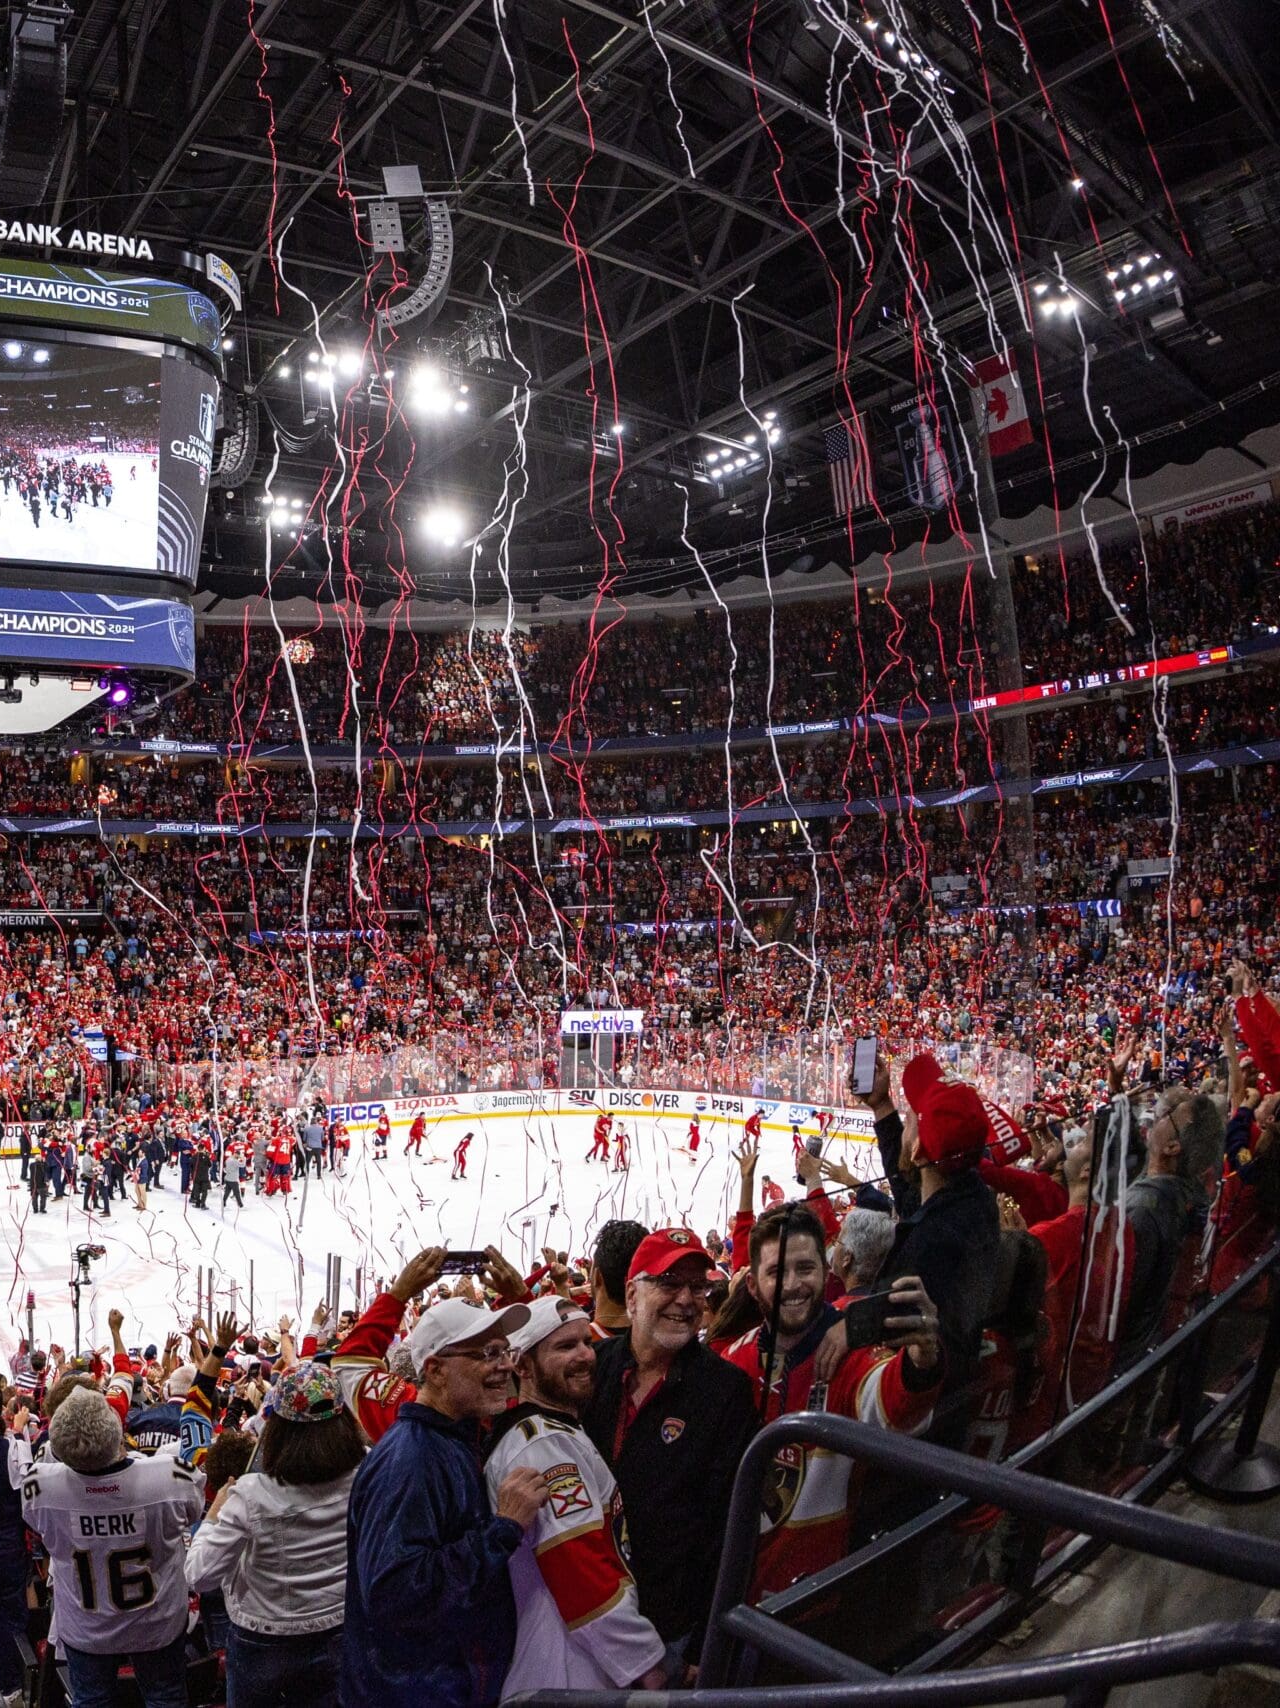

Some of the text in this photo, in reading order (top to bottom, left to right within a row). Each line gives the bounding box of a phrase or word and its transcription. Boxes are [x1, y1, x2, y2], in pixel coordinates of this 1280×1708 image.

[69, 229, 154, 261] ARENA
[119, 295, 150, 309] 2024
[1184, 491, 1255, 517] UNRULY FAN?
[108, 622, 135, 634] 2024
[1103, 673, 1110, 684] 2
[570, 1015, 634, 1032] nextiva
[395, 1096, 458, 1110] HONDA
[609, 1092, 679, 1108] DISCOVER
[712, 1100, 743, 1112] PEPSI
[325, 1104, 385, 1121] EICO
[789, 1107, 810, 1119] SAP
[85, 1484, 120, 1494] Reebok
[80, 1513, 136, 1537] BERK
[72, 1547, 157, 1612] 16
